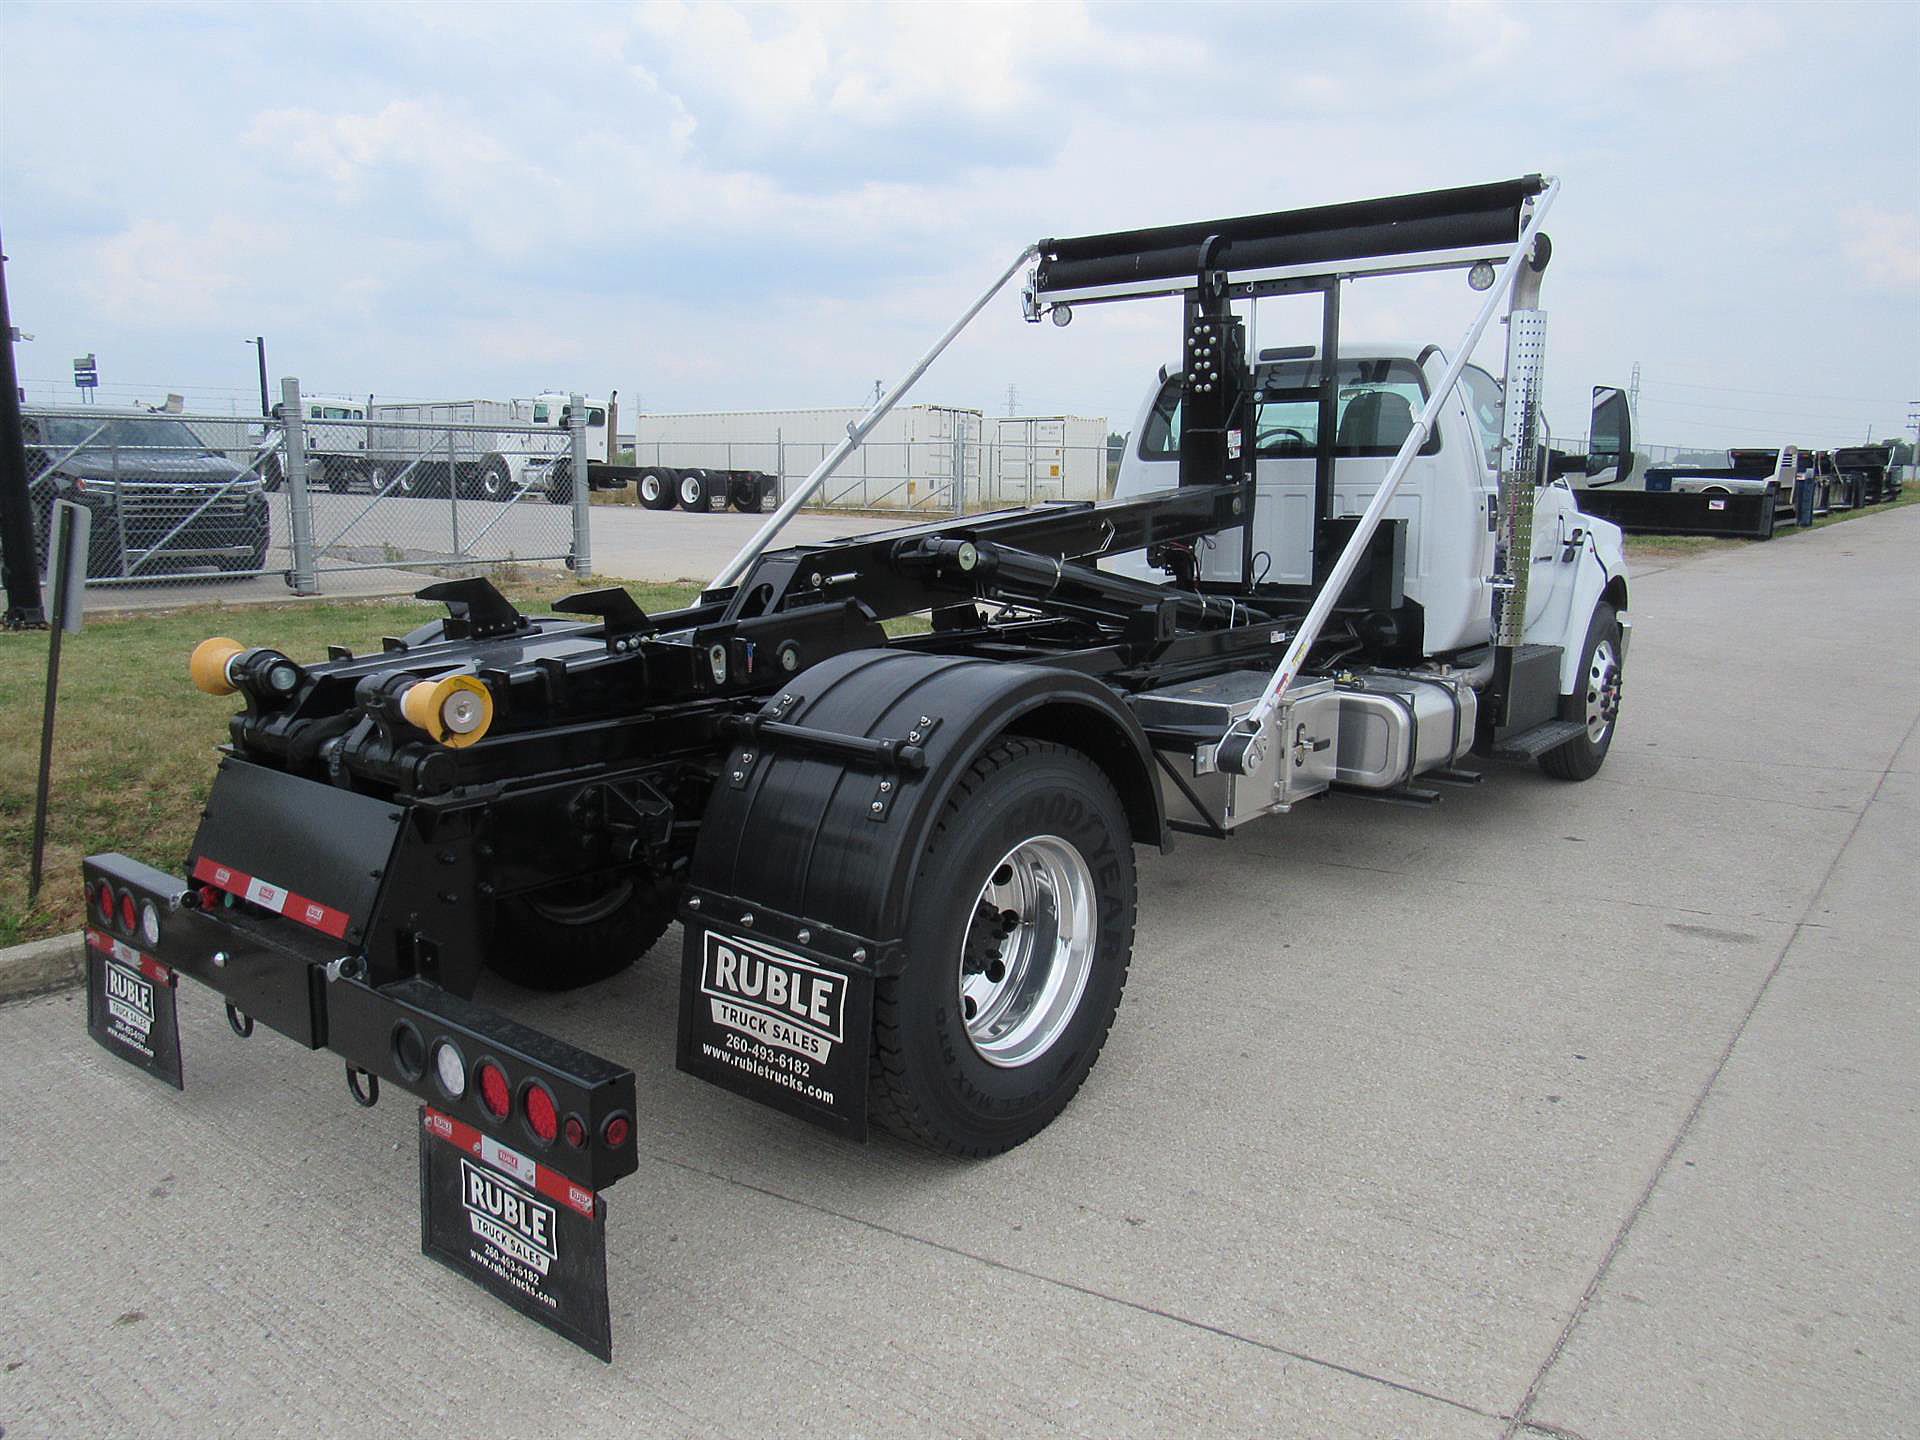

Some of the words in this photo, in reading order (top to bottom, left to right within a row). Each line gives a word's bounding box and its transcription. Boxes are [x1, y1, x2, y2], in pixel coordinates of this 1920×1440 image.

[1003, 792, 1123, 961] GOODYEAR
[110, 969, 150, 1013] RUBLE
[716, 945, 833, 1026] RUBLE
[721, 1005, 768, 1034] TRUCK
[772, 1025, 819, 1054] SALES
[726, 1033, 810, 1078] 260-493-6182
[703, 1042, 834, 1105] www.rubletrucks.com
[471, 1172, 547, 1246] RUBLE
[477, 1218, 508, 1246] TRUCK
[511, 1240, 541, 1266] SALES
[485, 1244, 539, 1285] 260-493-6182
[470, 1249, 557, 1308] www.rubletrucks.com
